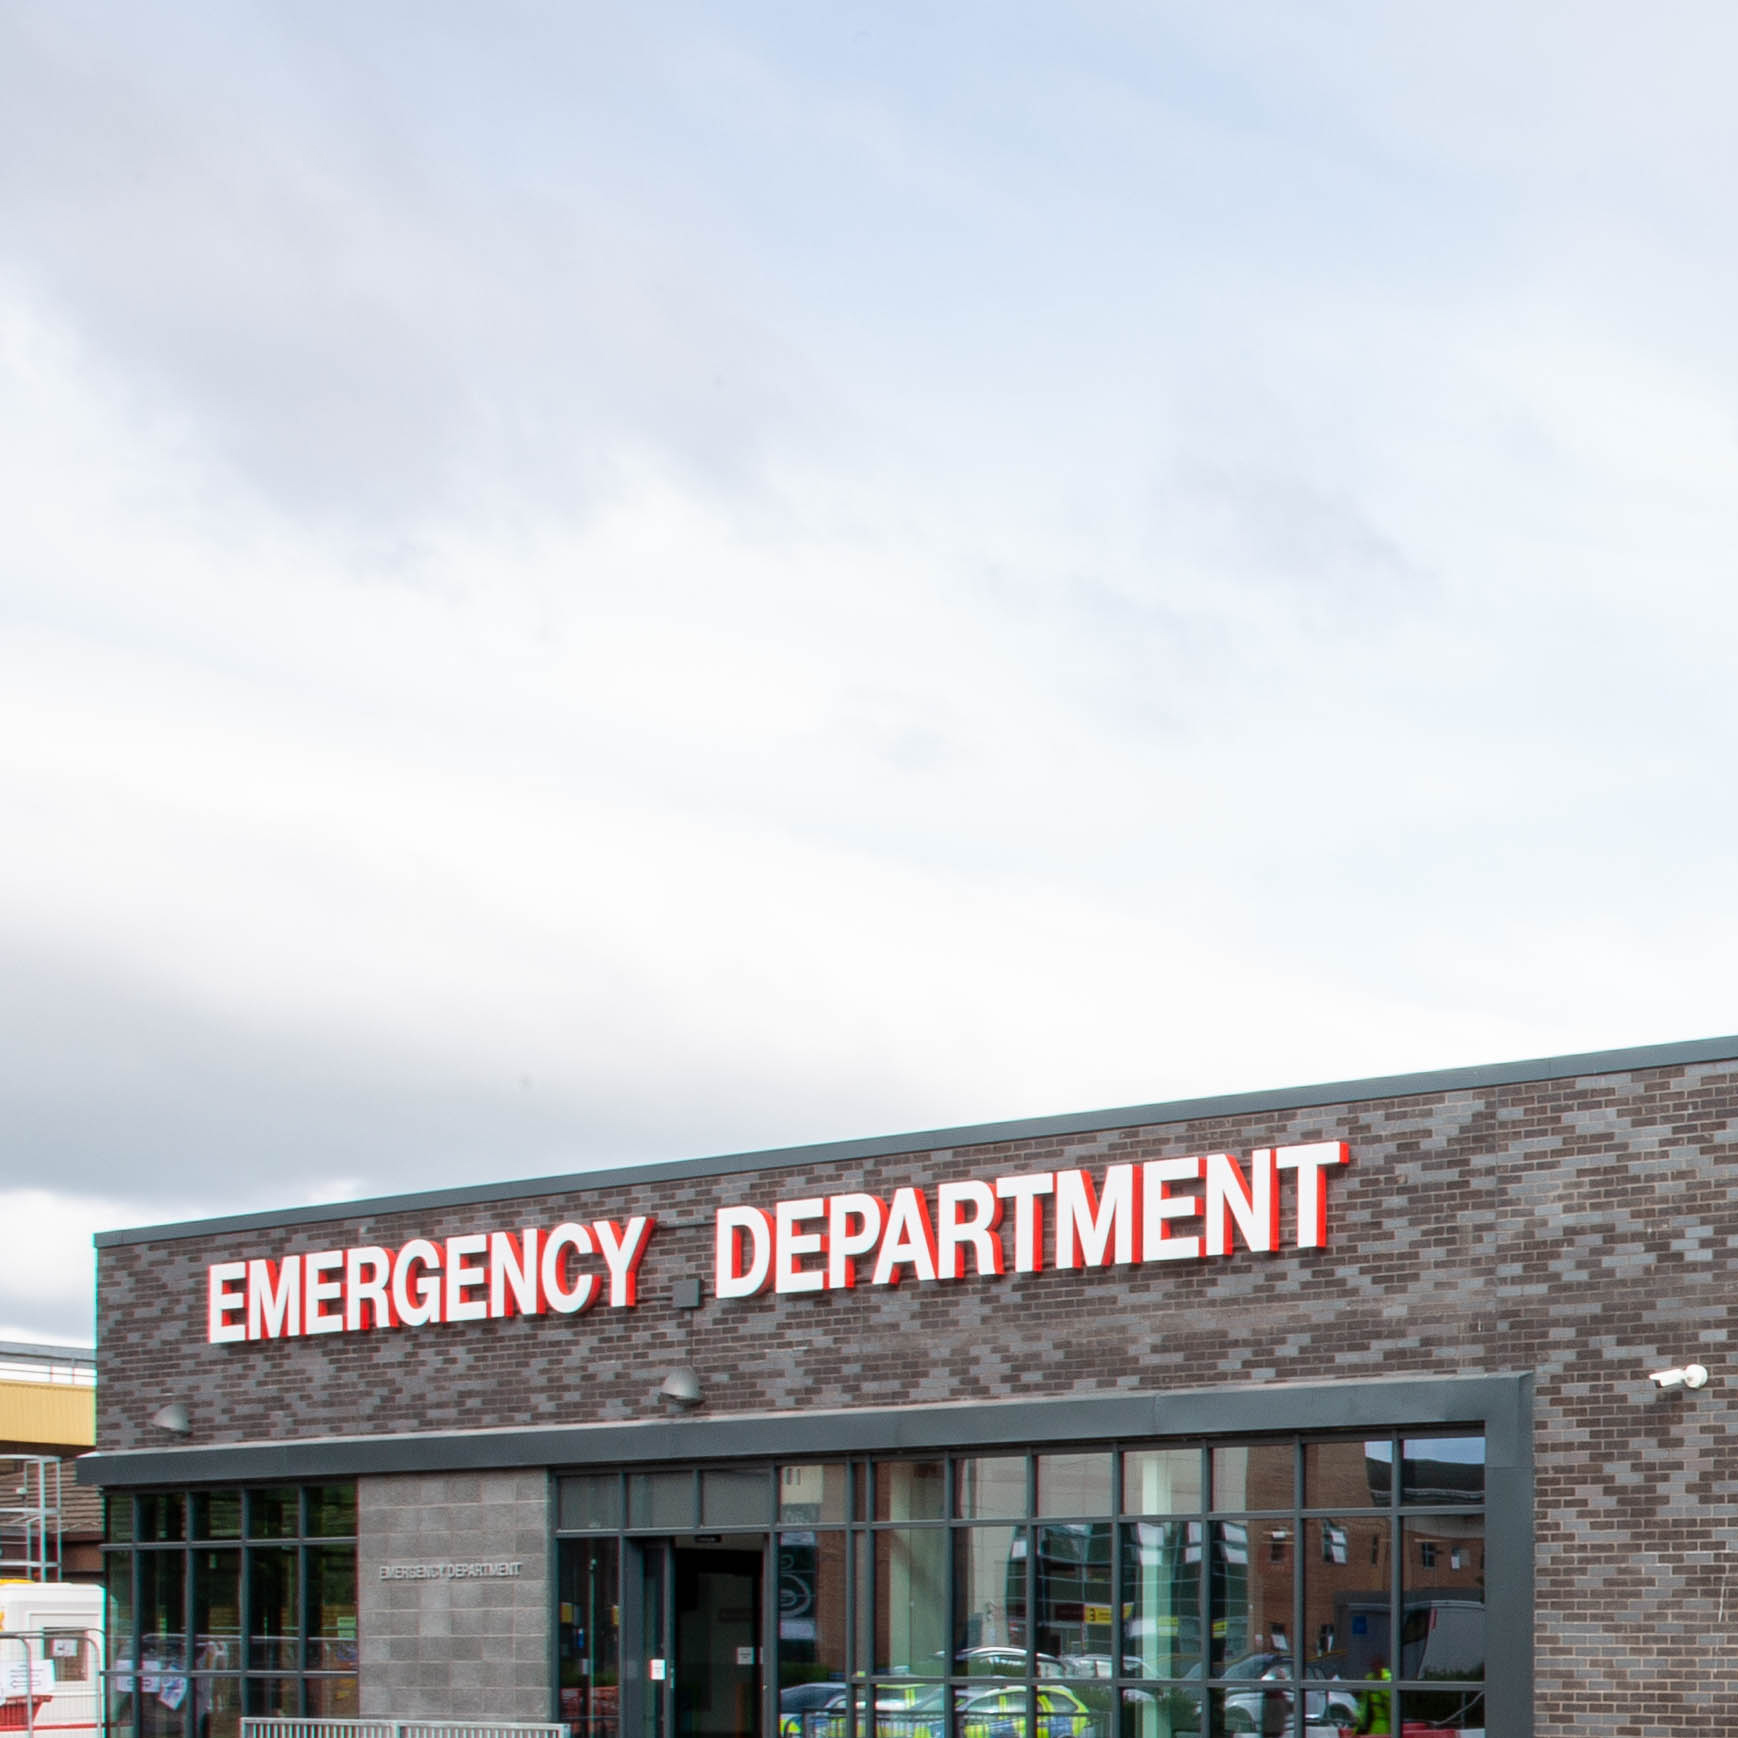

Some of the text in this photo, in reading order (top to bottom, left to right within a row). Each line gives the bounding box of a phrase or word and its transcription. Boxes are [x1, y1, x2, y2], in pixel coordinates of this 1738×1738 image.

[206, 1140, 1350, 1345] EMERGENCY DEPARTMENT
[380, 1562, 523, 1579] EMERGENCY DEPARTMENT
